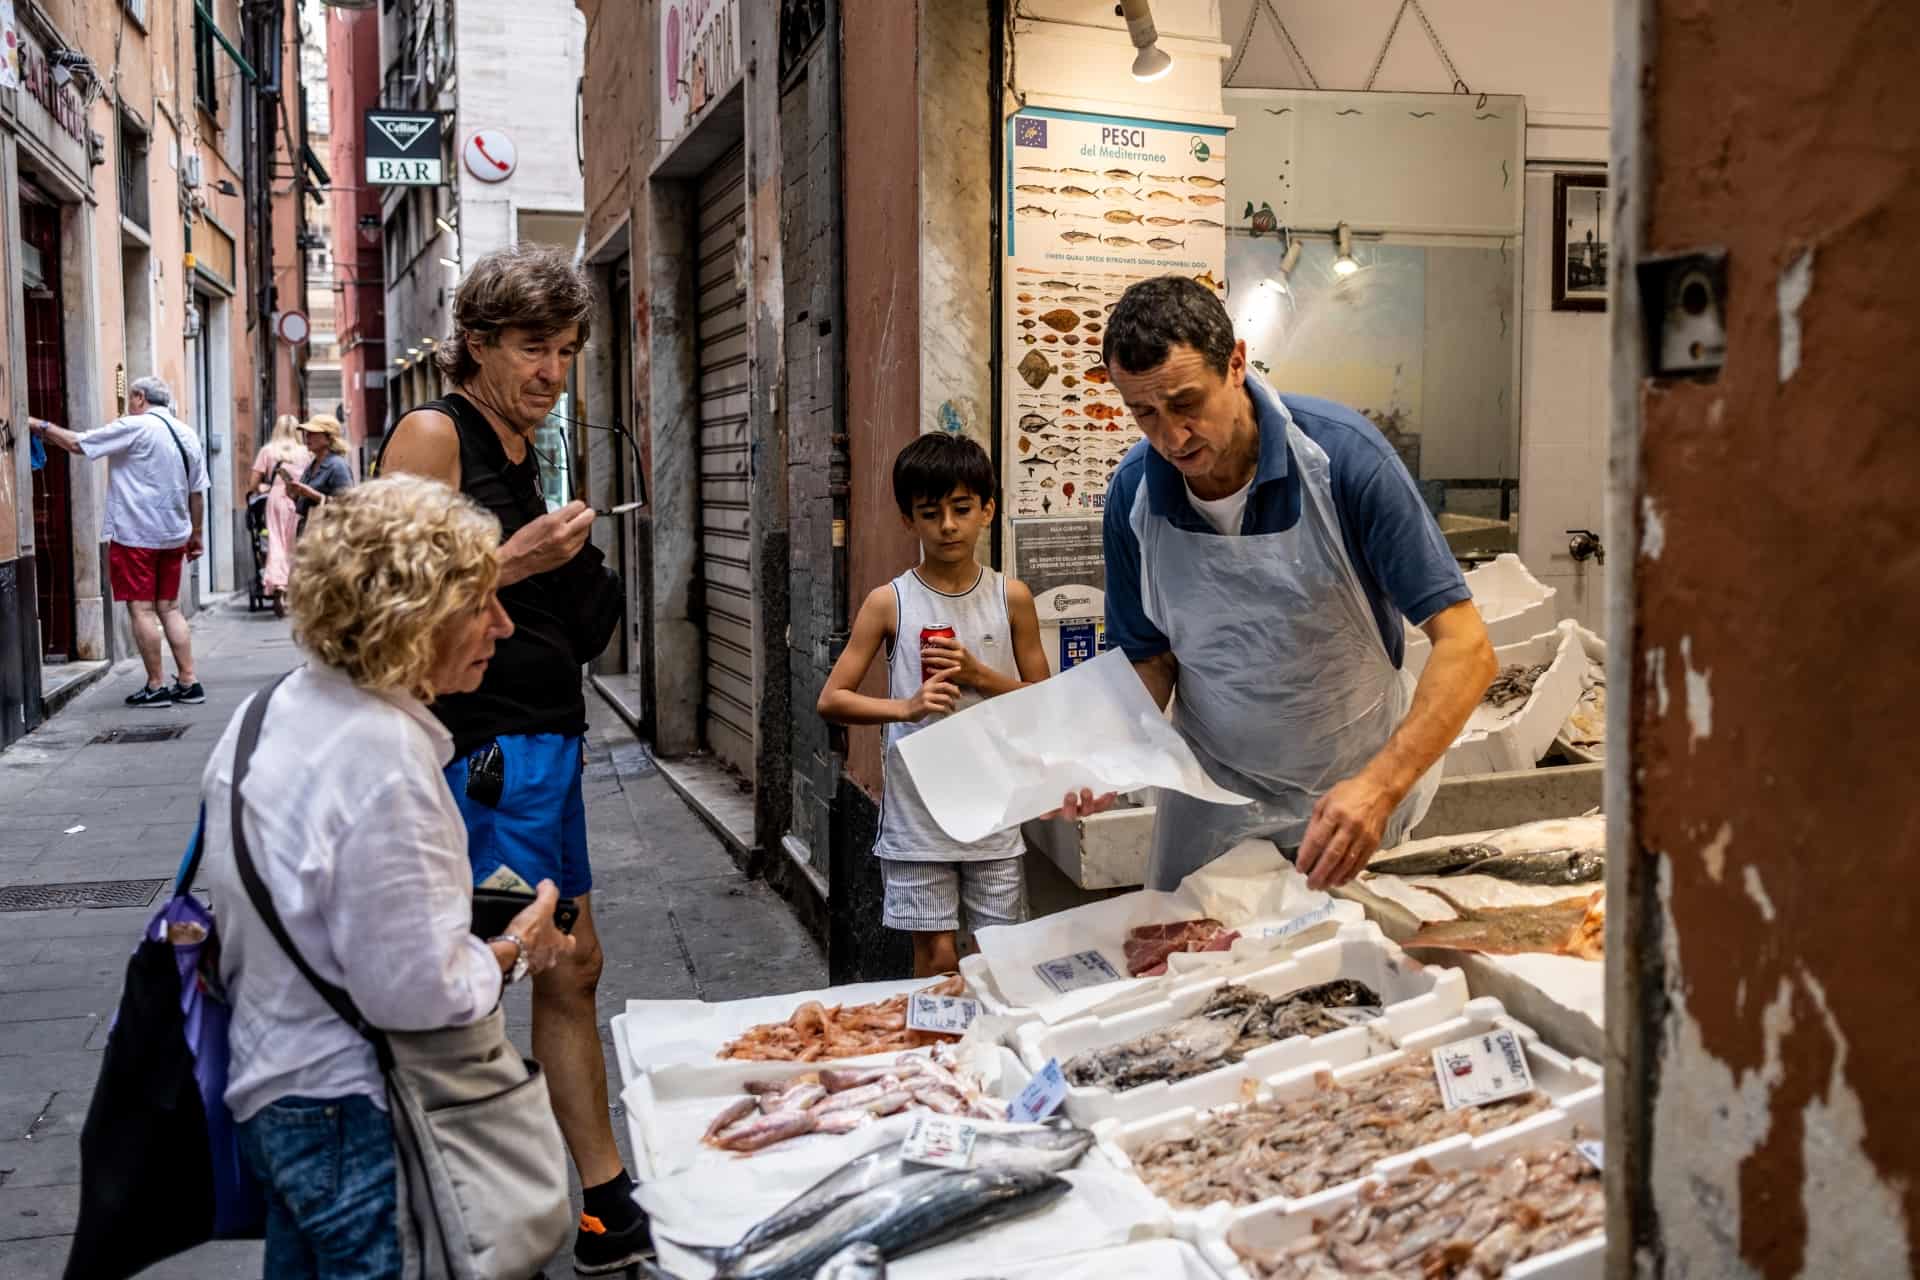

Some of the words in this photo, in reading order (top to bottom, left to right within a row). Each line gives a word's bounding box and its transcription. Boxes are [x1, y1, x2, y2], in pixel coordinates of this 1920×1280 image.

[1102, 127, 1145, 148] PESCI
[1080, 144, 1096, 157] del
[1099, 147, 1166, 163] Mediterraneo
[379, 161, 431, 181] BAR
